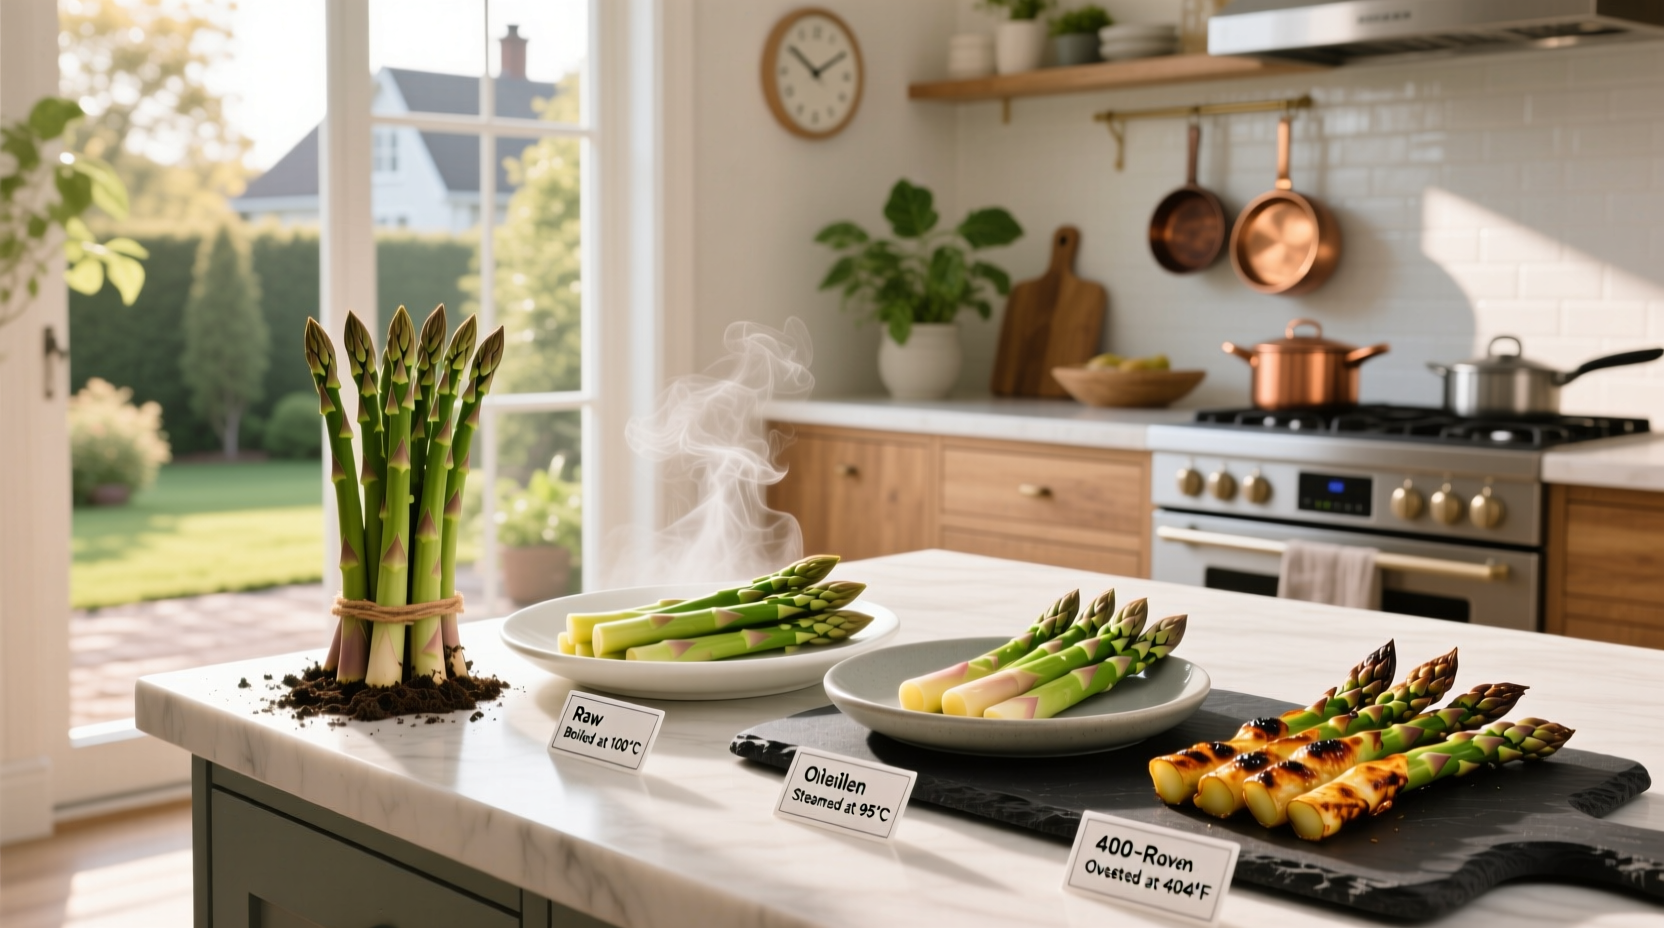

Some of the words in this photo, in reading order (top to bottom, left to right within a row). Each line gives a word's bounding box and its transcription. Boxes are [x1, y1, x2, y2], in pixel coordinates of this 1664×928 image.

[572, 706, 604, 726] Raw
[597, 737, 608, 749] at
[844, 802, 856, 815] at
[1095, 835, 1193, 873] 400-Roven
